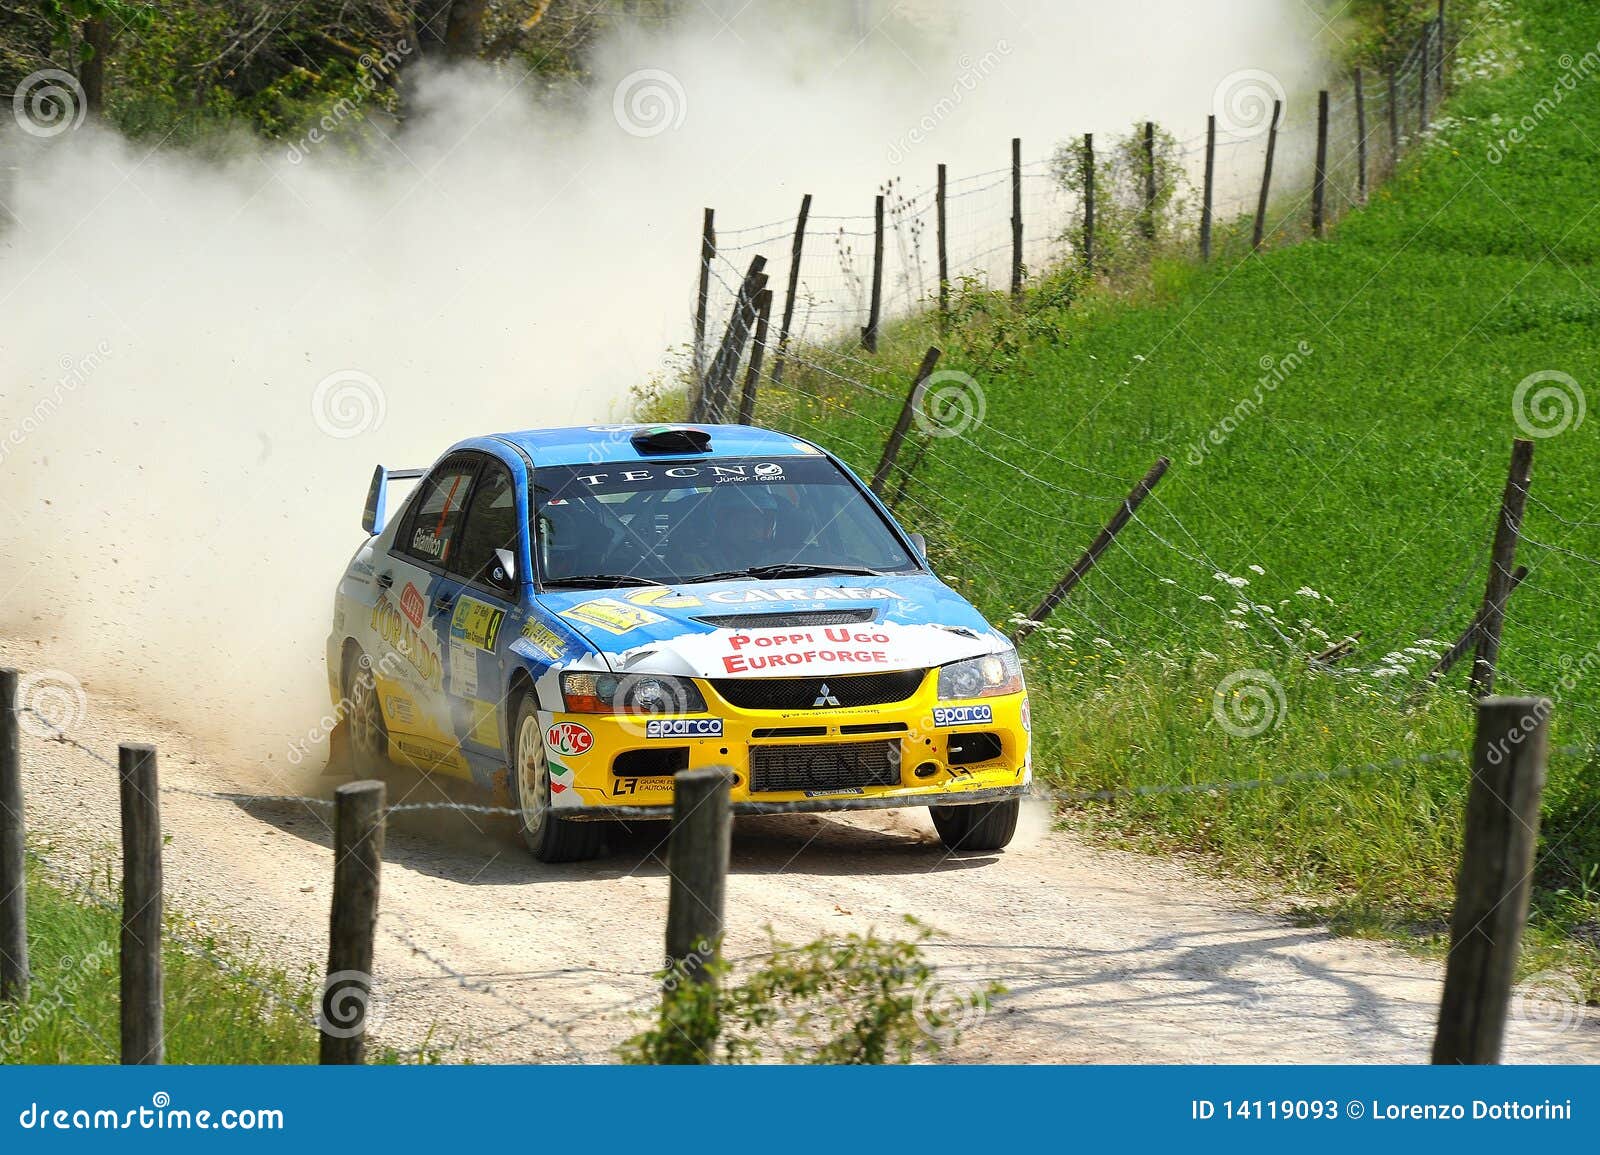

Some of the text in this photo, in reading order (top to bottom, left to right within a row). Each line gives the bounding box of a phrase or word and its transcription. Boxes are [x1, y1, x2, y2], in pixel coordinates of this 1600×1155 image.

[708, 587, 904, 604] CARAFA
[722, 650, 888, 674] EUROFORGE
[934, 705, 992, 726] sparco
[549, 723, 589, 752] M&C
[647, 720, 722, 738] sparco
